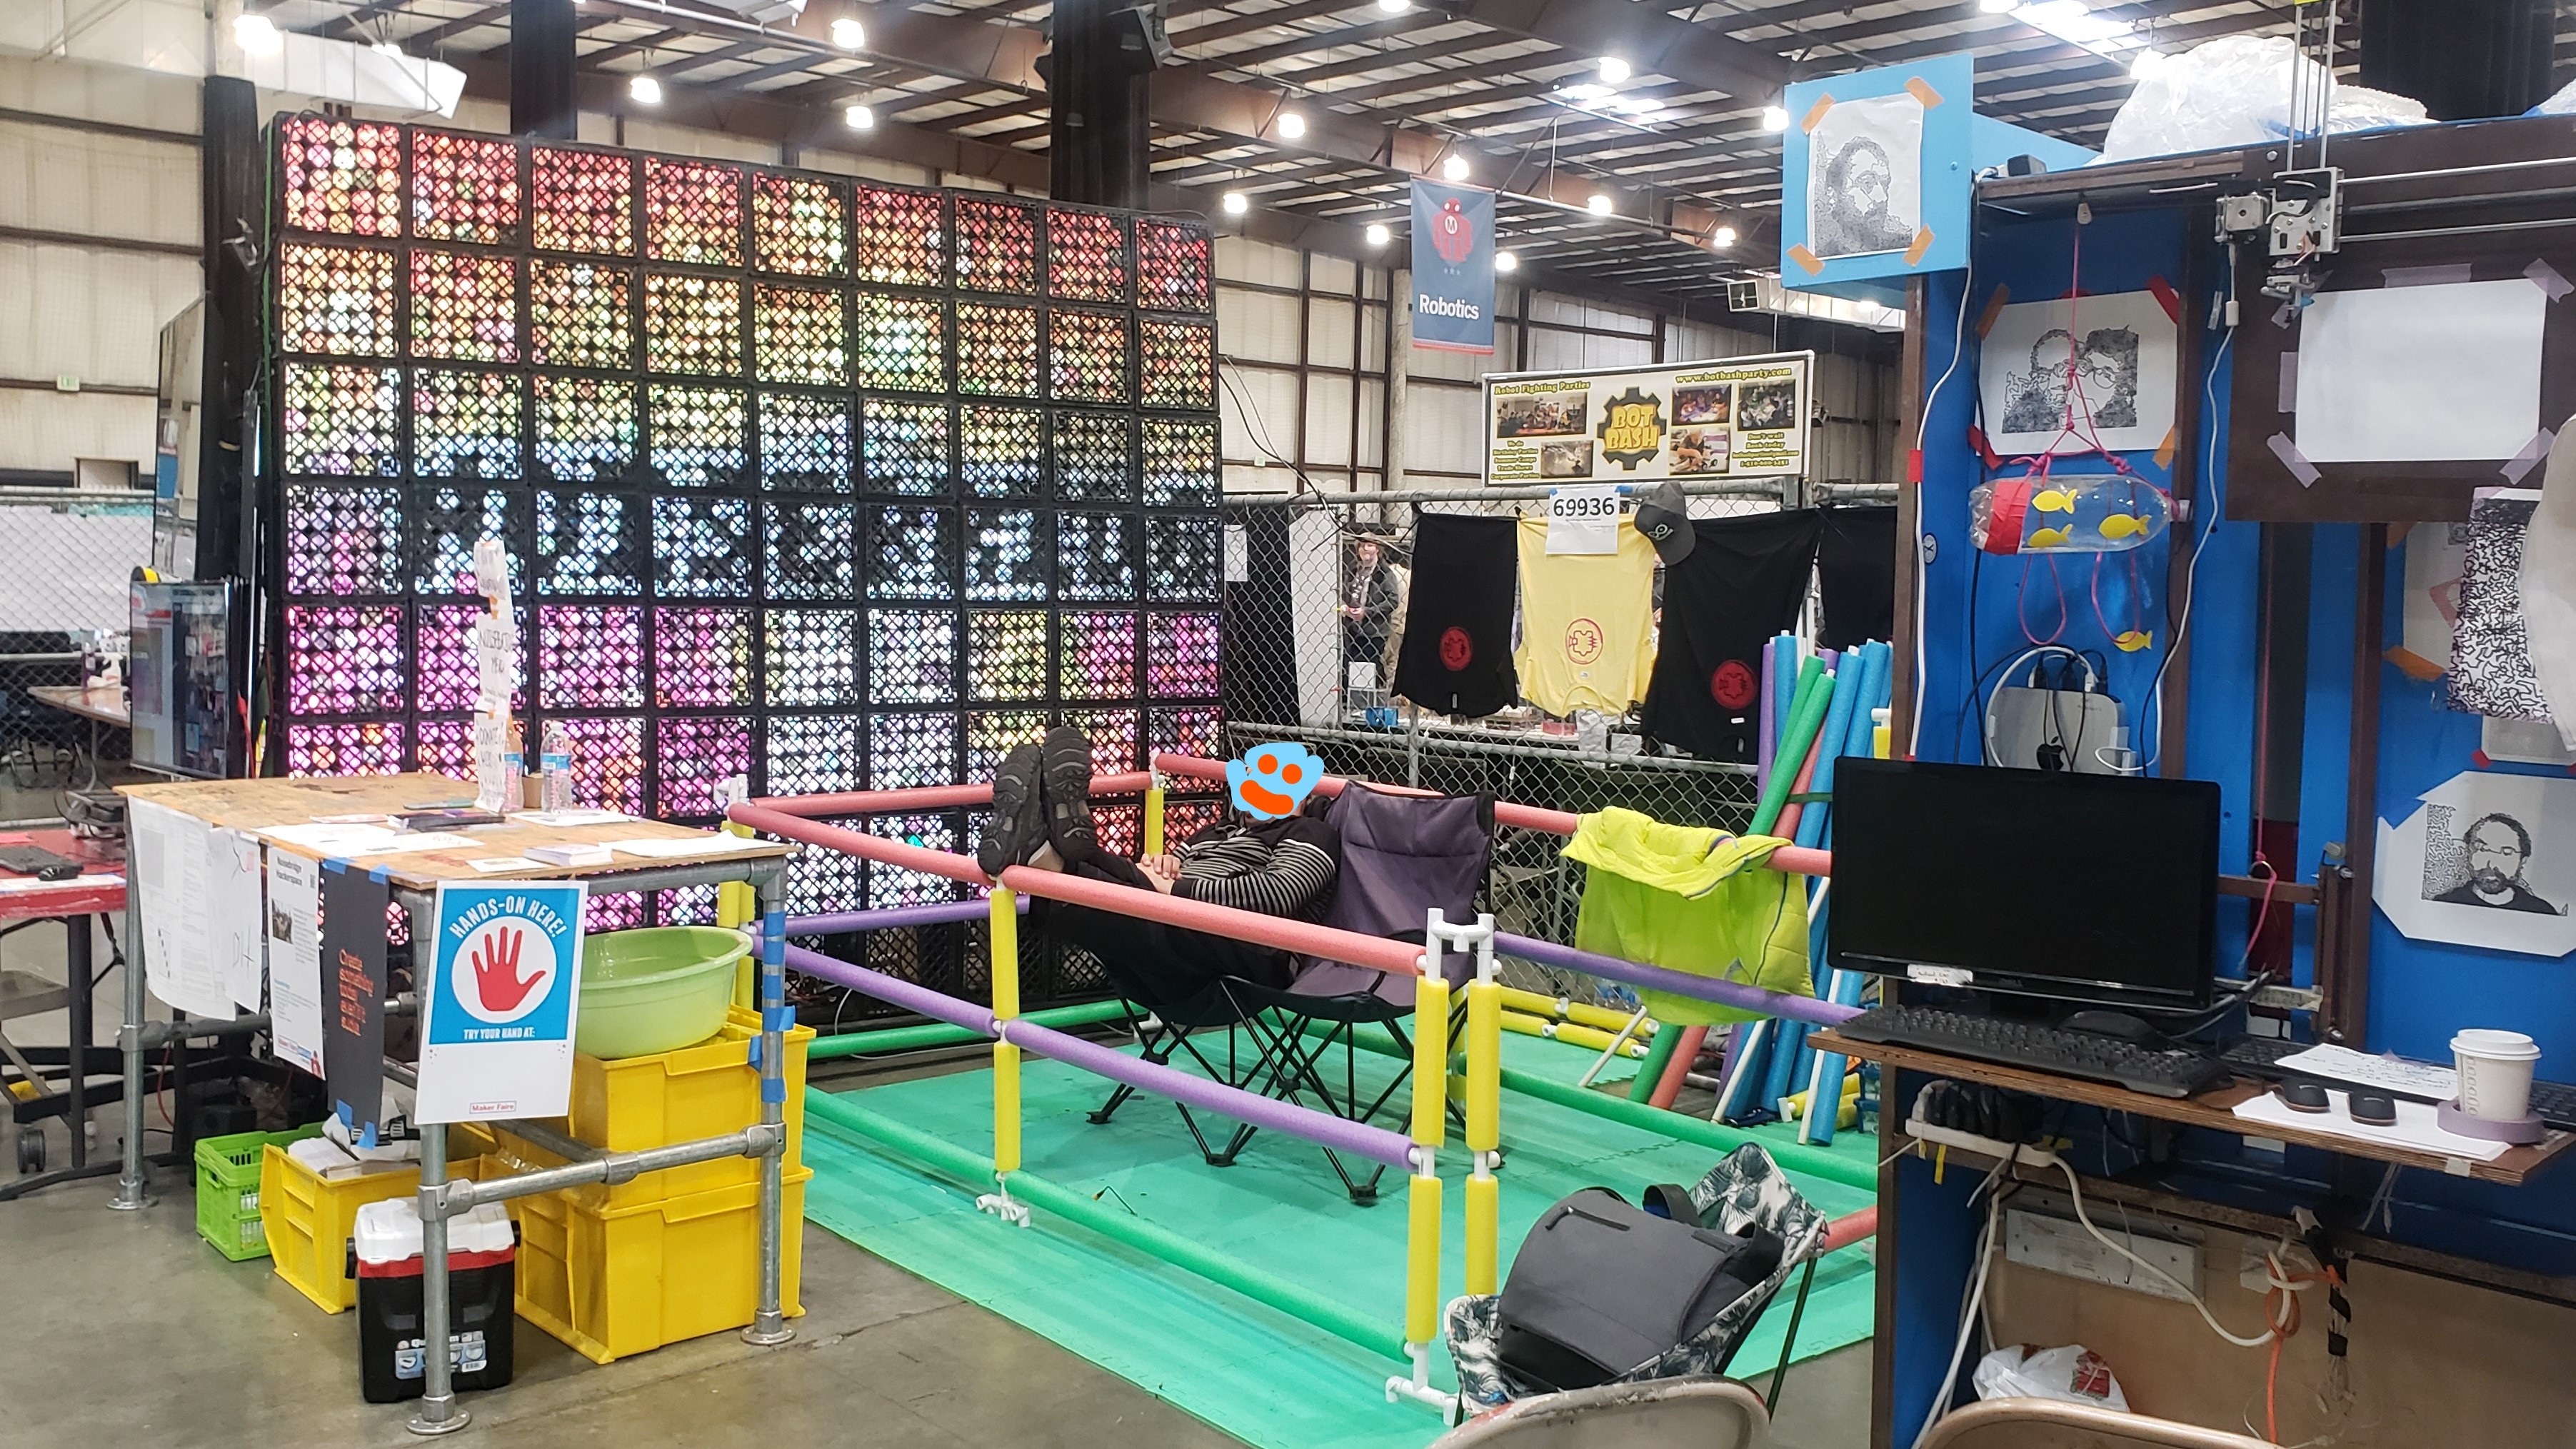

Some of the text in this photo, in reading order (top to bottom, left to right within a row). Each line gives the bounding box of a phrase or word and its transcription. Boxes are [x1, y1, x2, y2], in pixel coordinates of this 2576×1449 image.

[1419, 294, 1480, 320] Robotics
[1675, 368, 1792, 383] www.botbashparty.com
[1494, 381, 1591, 395] Robot Fighting Parties
[1612, 405, 1655, 428] BOT
[1605, 427, 1658, 449] BASH
[1553, 497, 1615, 517] 69936
[449, 895, 567, 938] HANDS-ON HERE!
[463, 1027, 536, 1040] TRY YOUR HAND AT:
